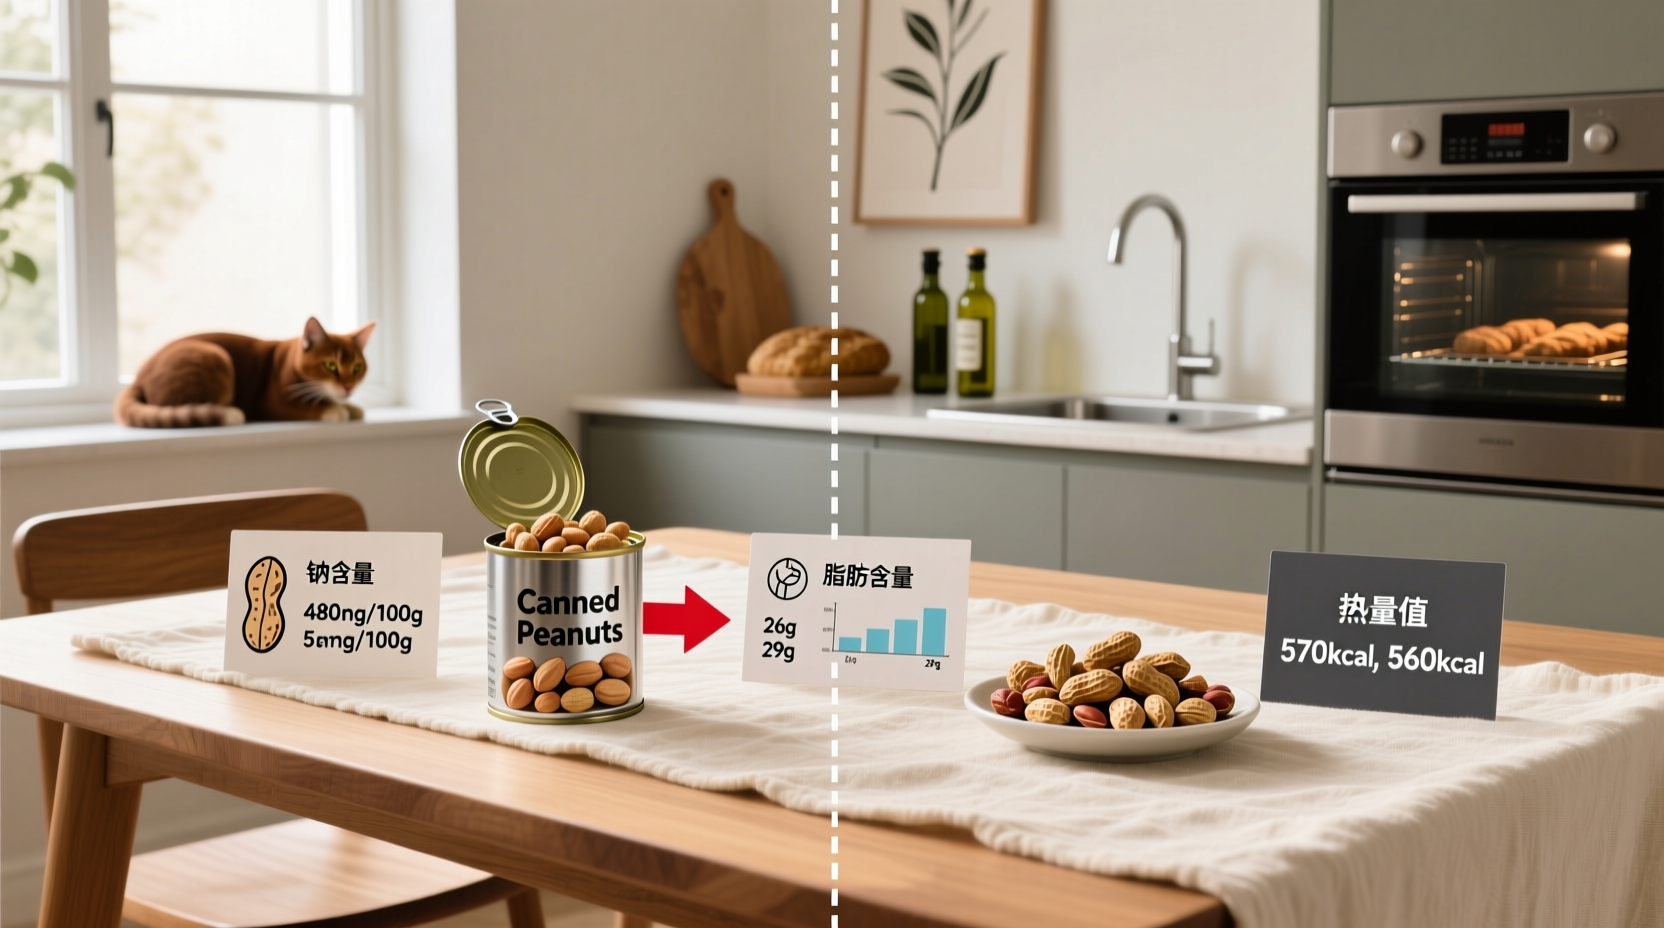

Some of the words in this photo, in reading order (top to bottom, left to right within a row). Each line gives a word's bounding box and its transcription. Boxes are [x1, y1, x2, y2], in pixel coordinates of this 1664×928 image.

[305, 560, 375, 585] 钠含量
[823, 562, 914, 590] 脂肪含量
[517, 586, 620, 615] Canned
[1338, 592, 1429, 628] 热量值
[518, 619, 623, 647] Peanuts
[763, 616, 797, 640] 26g
[761, 640, 796, 664] 29g
[1280, 637, 1379, 674] 570kcal,
[1387, 644, 1485, 675] 560kcal
